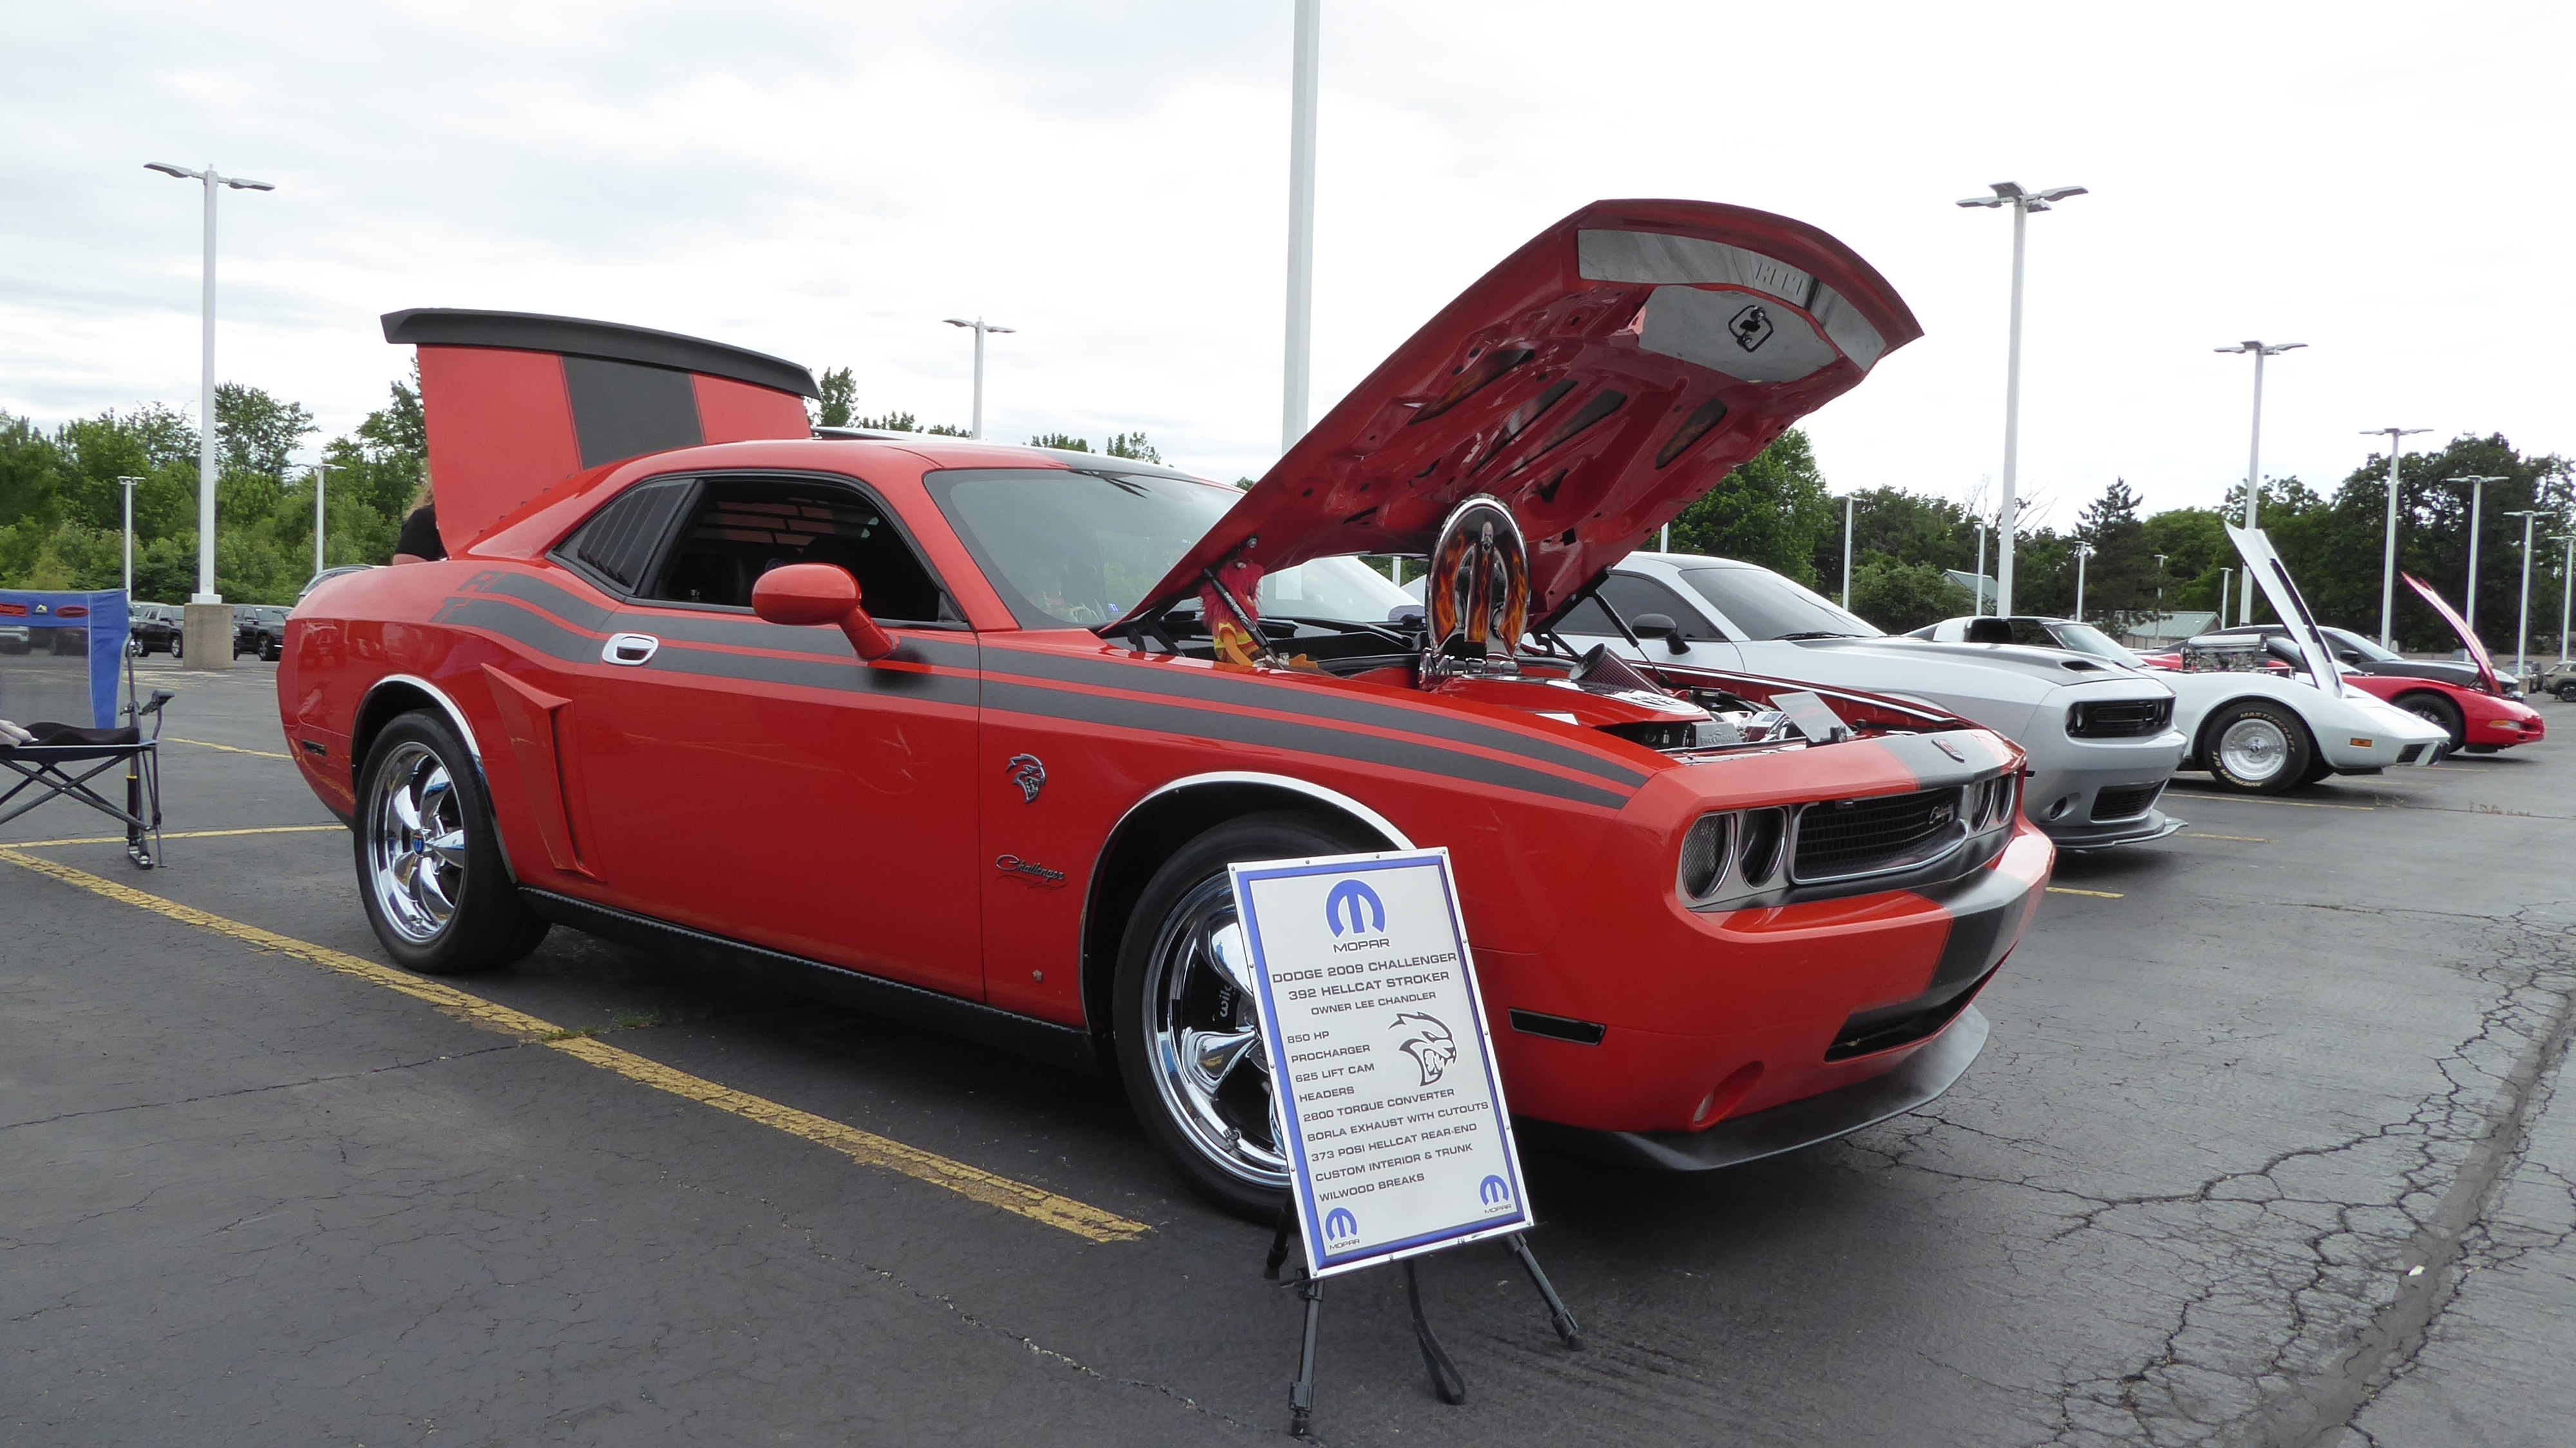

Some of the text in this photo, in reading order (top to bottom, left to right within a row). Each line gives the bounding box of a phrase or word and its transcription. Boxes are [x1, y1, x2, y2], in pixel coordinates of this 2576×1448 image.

[2240, 712, 2296, 753] MASTERCRAFT
[996, 855, 1065, 882] Challenger
[1334, 939, 1390, 953] MOPAR
[1273, 953, 1456, 983] DODGE 2009 CHALLENGER
[1289, 971, 1449, 1000] 392 HELLCAT STROKER
[1311, 992, 1435, 1015] OWNER LEE CHANDLER
[1287, 1031, 1329, 1043] 850 HP
[1291, 1045, 1370, 1063] PROCHARGER
[1296, 1063, 1374, 1082] 625 LIFT CAM
[1300, 1087, 1354, 1102] HEADERS
[1303, 1089, 1454, 1121] 2800 TORQUE CONVERTER
[1307, 1102, 1488, 1141] BORLA EXHAUST WITH CUTOUTS
[1312, 1150, 1334, 1161] 373
[1338, 1145, 1365, 1156] POSI
[1368, 1135, 1417, 1150] HELLCAT
[1316, 1165, 1365, 1181] CUSTOM
[1369, 1154, 1421, 1171] INTERIOR
[1435, 1143, 1472, 1157] TRUNK
[1319, 1174, 1424, 1201] WILWOOD BREAKS
[1485, 1205, 1511, 1214] MOPAR
[1330, 1239, 1359, 1250] MOPAR
